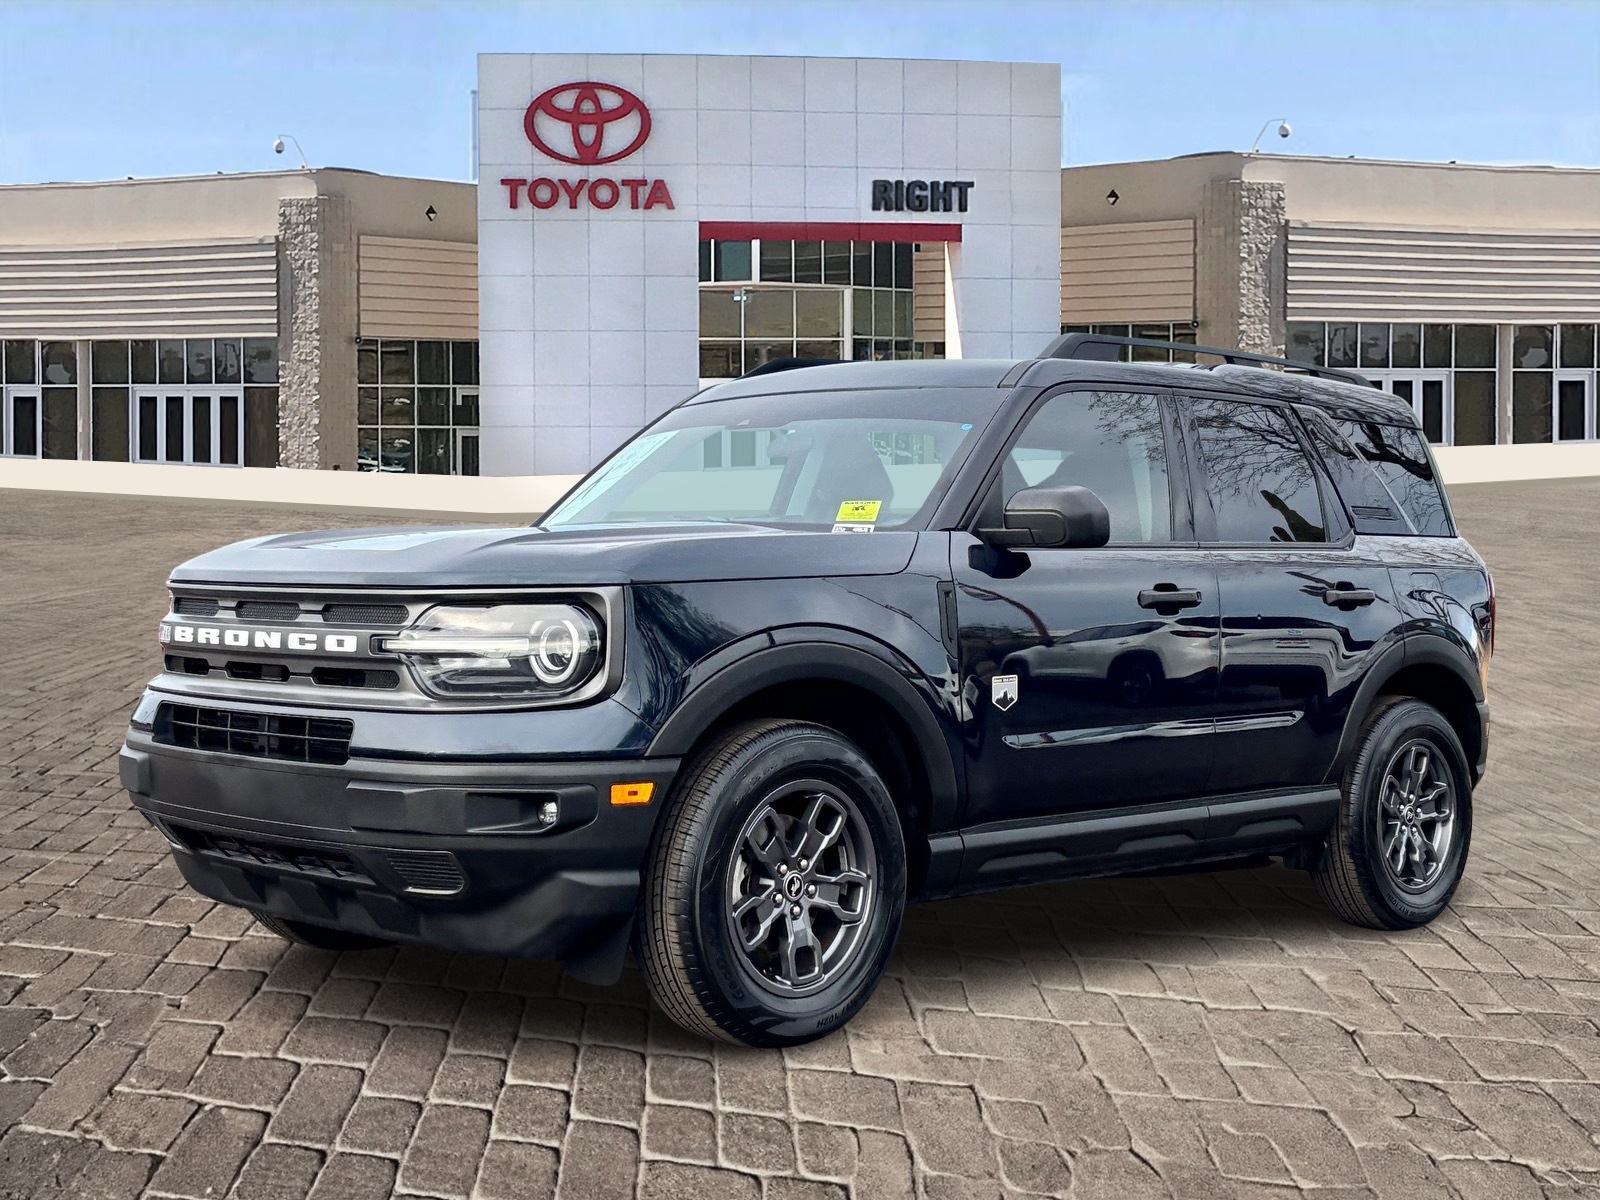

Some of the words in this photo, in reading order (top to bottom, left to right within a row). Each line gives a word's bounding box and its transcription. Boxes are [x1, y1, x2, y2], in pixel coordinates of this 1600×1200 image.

[500, 177, 675, 210] TOYOTA
[872, 179, 975, 212] RIGHT
[174, 625, 358, 653] BRONCO
